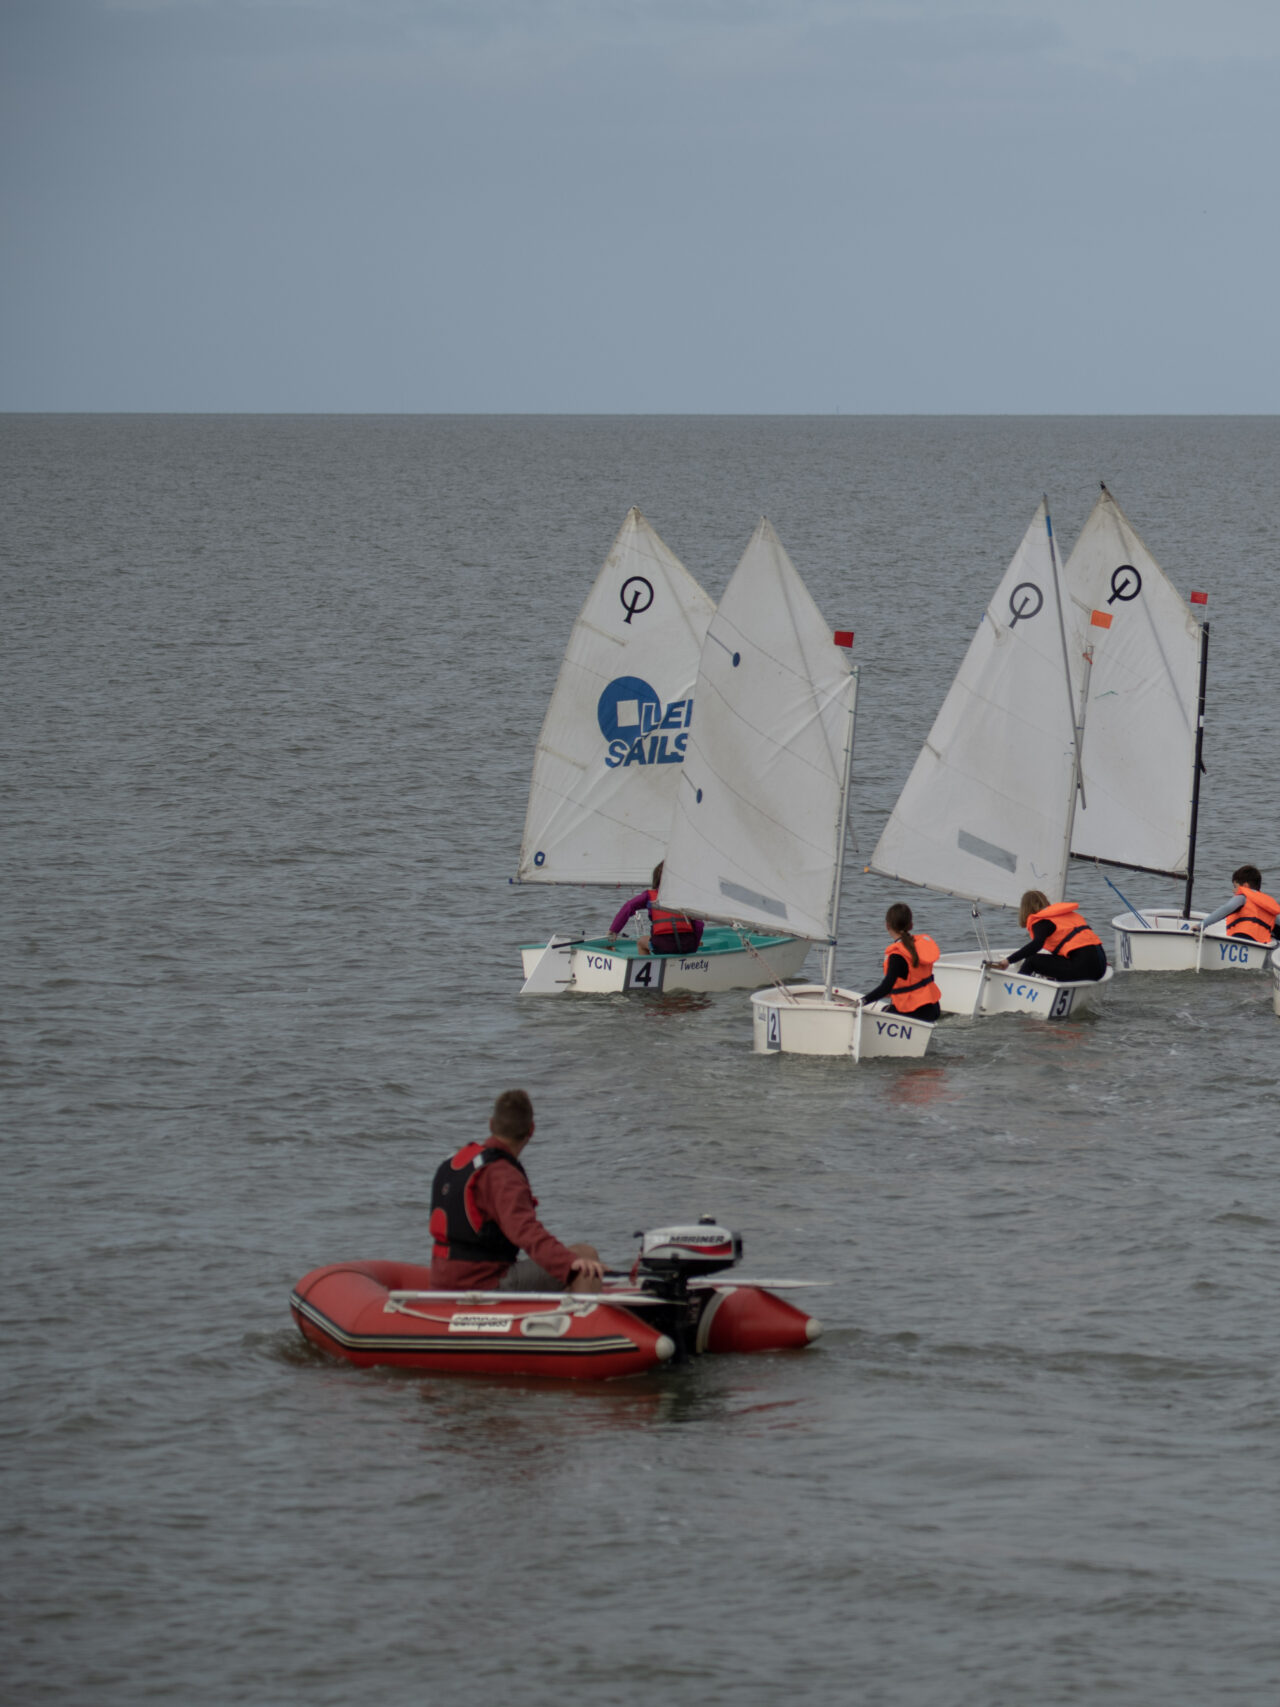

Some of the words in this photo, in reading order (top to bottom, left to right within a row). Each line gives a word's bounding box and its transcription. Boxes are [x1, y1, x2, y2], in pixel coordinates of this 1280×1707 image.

[586, 955, 612, 971] YCN
[1219, 943, 1249, 963] YCG
[634, 962, 652, 987] 4
[678, 958, 709, 973] Tweety
[1004, 982, 1038, 1002] YCN
[1056, 989, 1069, 1015] 5
[876, 1021, 912, 1039] YCN
